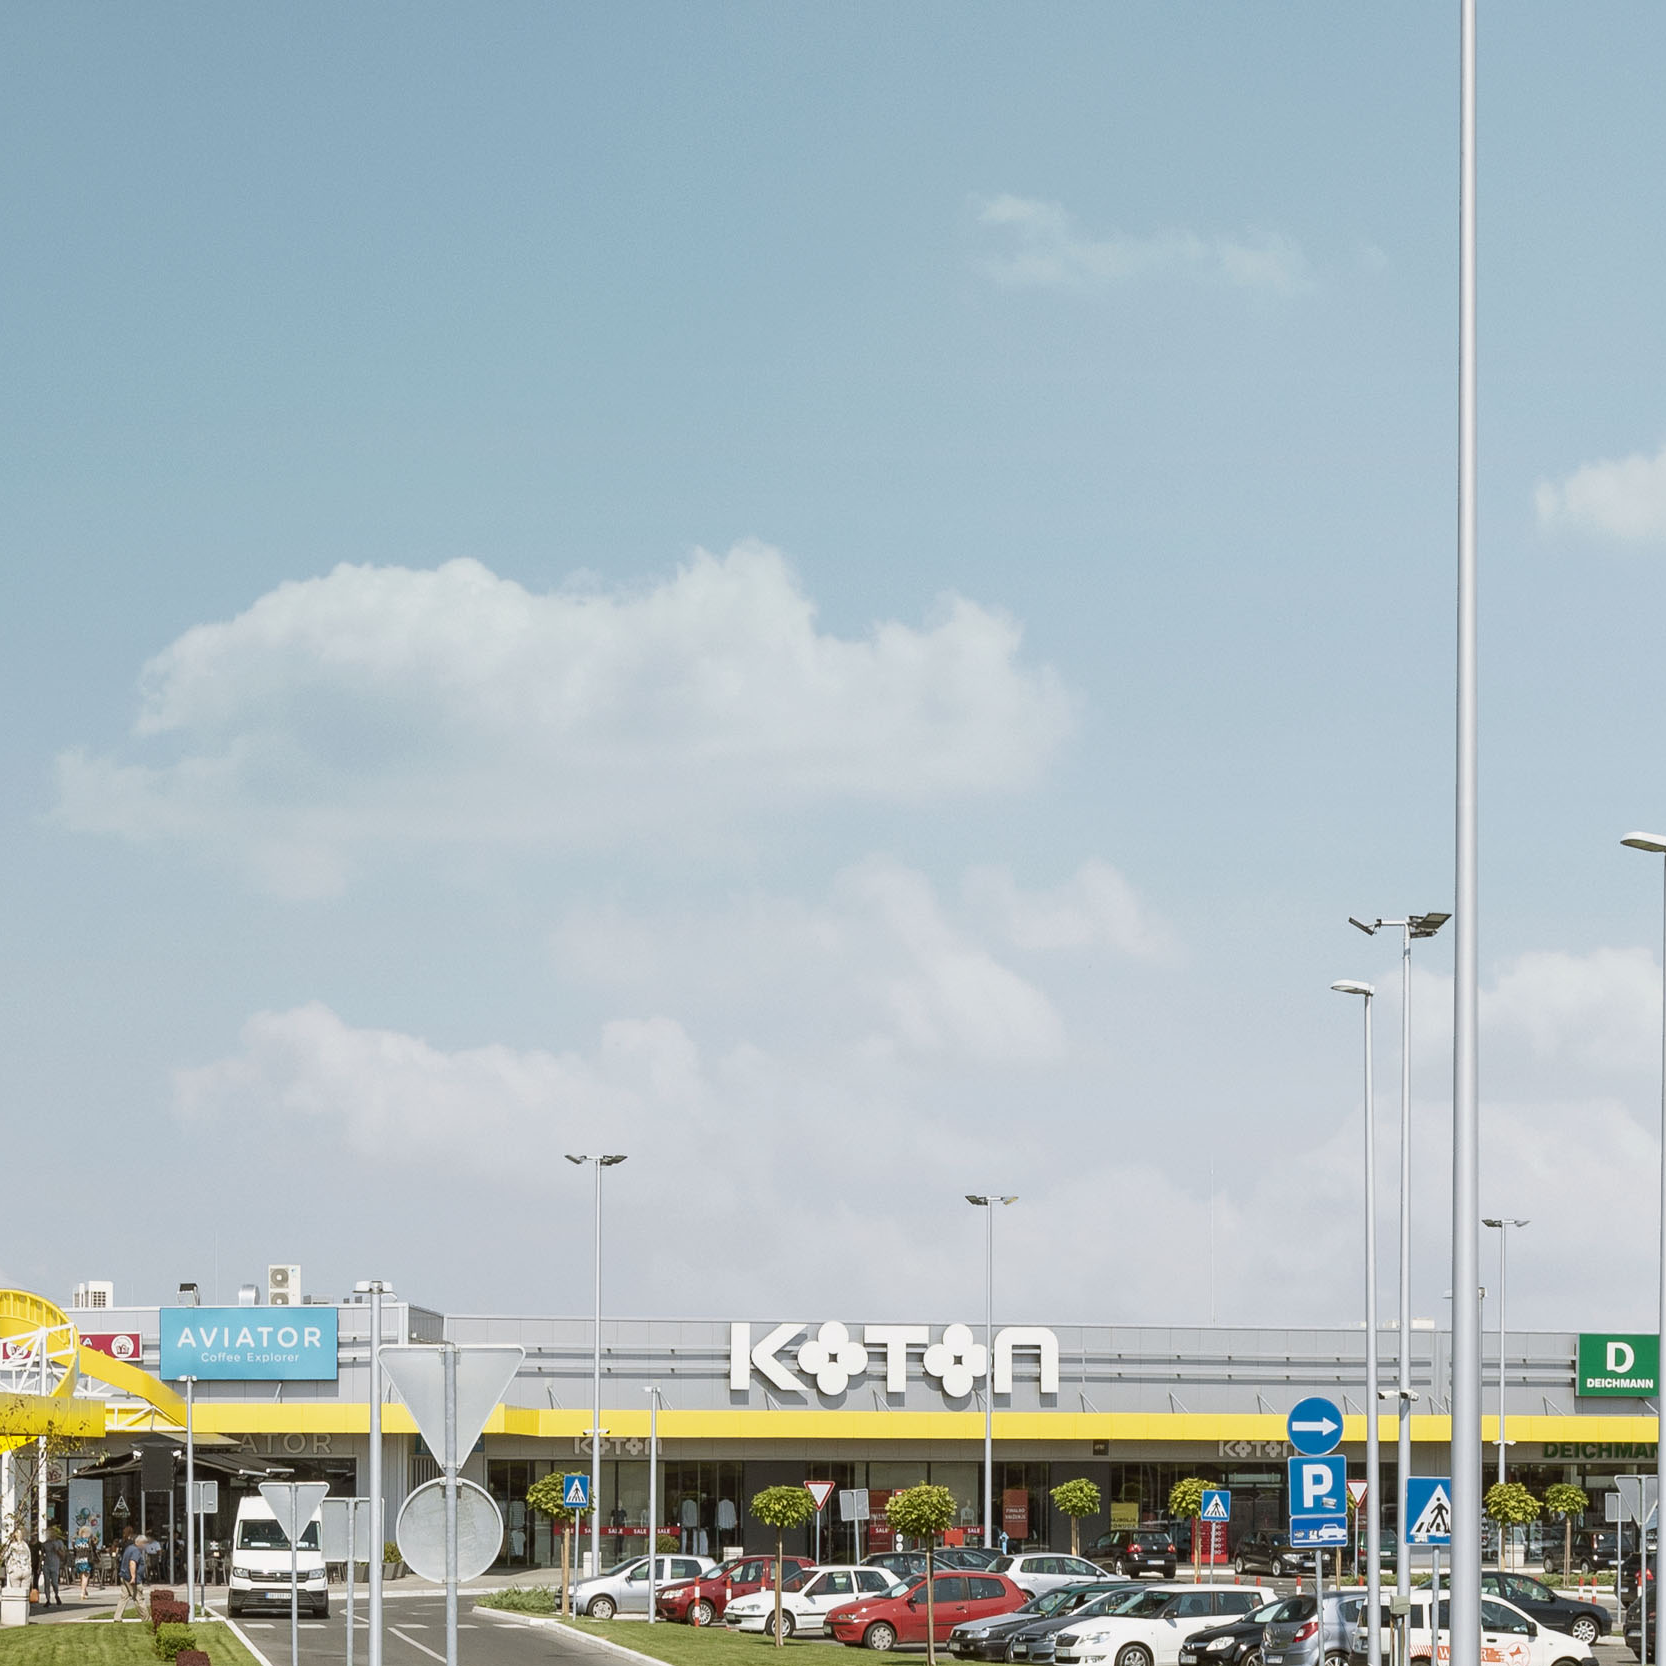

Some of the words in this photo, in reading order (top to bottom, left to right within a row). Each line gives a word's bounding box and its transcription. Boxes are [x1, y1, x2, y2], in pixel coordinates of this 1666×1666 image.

[177, 1326, 322, 1348] AVIATOR
[201, 1352, 241, 1363] Coffee
[247, 1352, 299, 1364] Explorer
[730, 1321, 1059, 1397] KOTON
[1606, 1342, 1634, 1374] D
[1587, 1378, 1654, 1389] DEICHMANN
[1302, 1464, 1333, 1508] P
